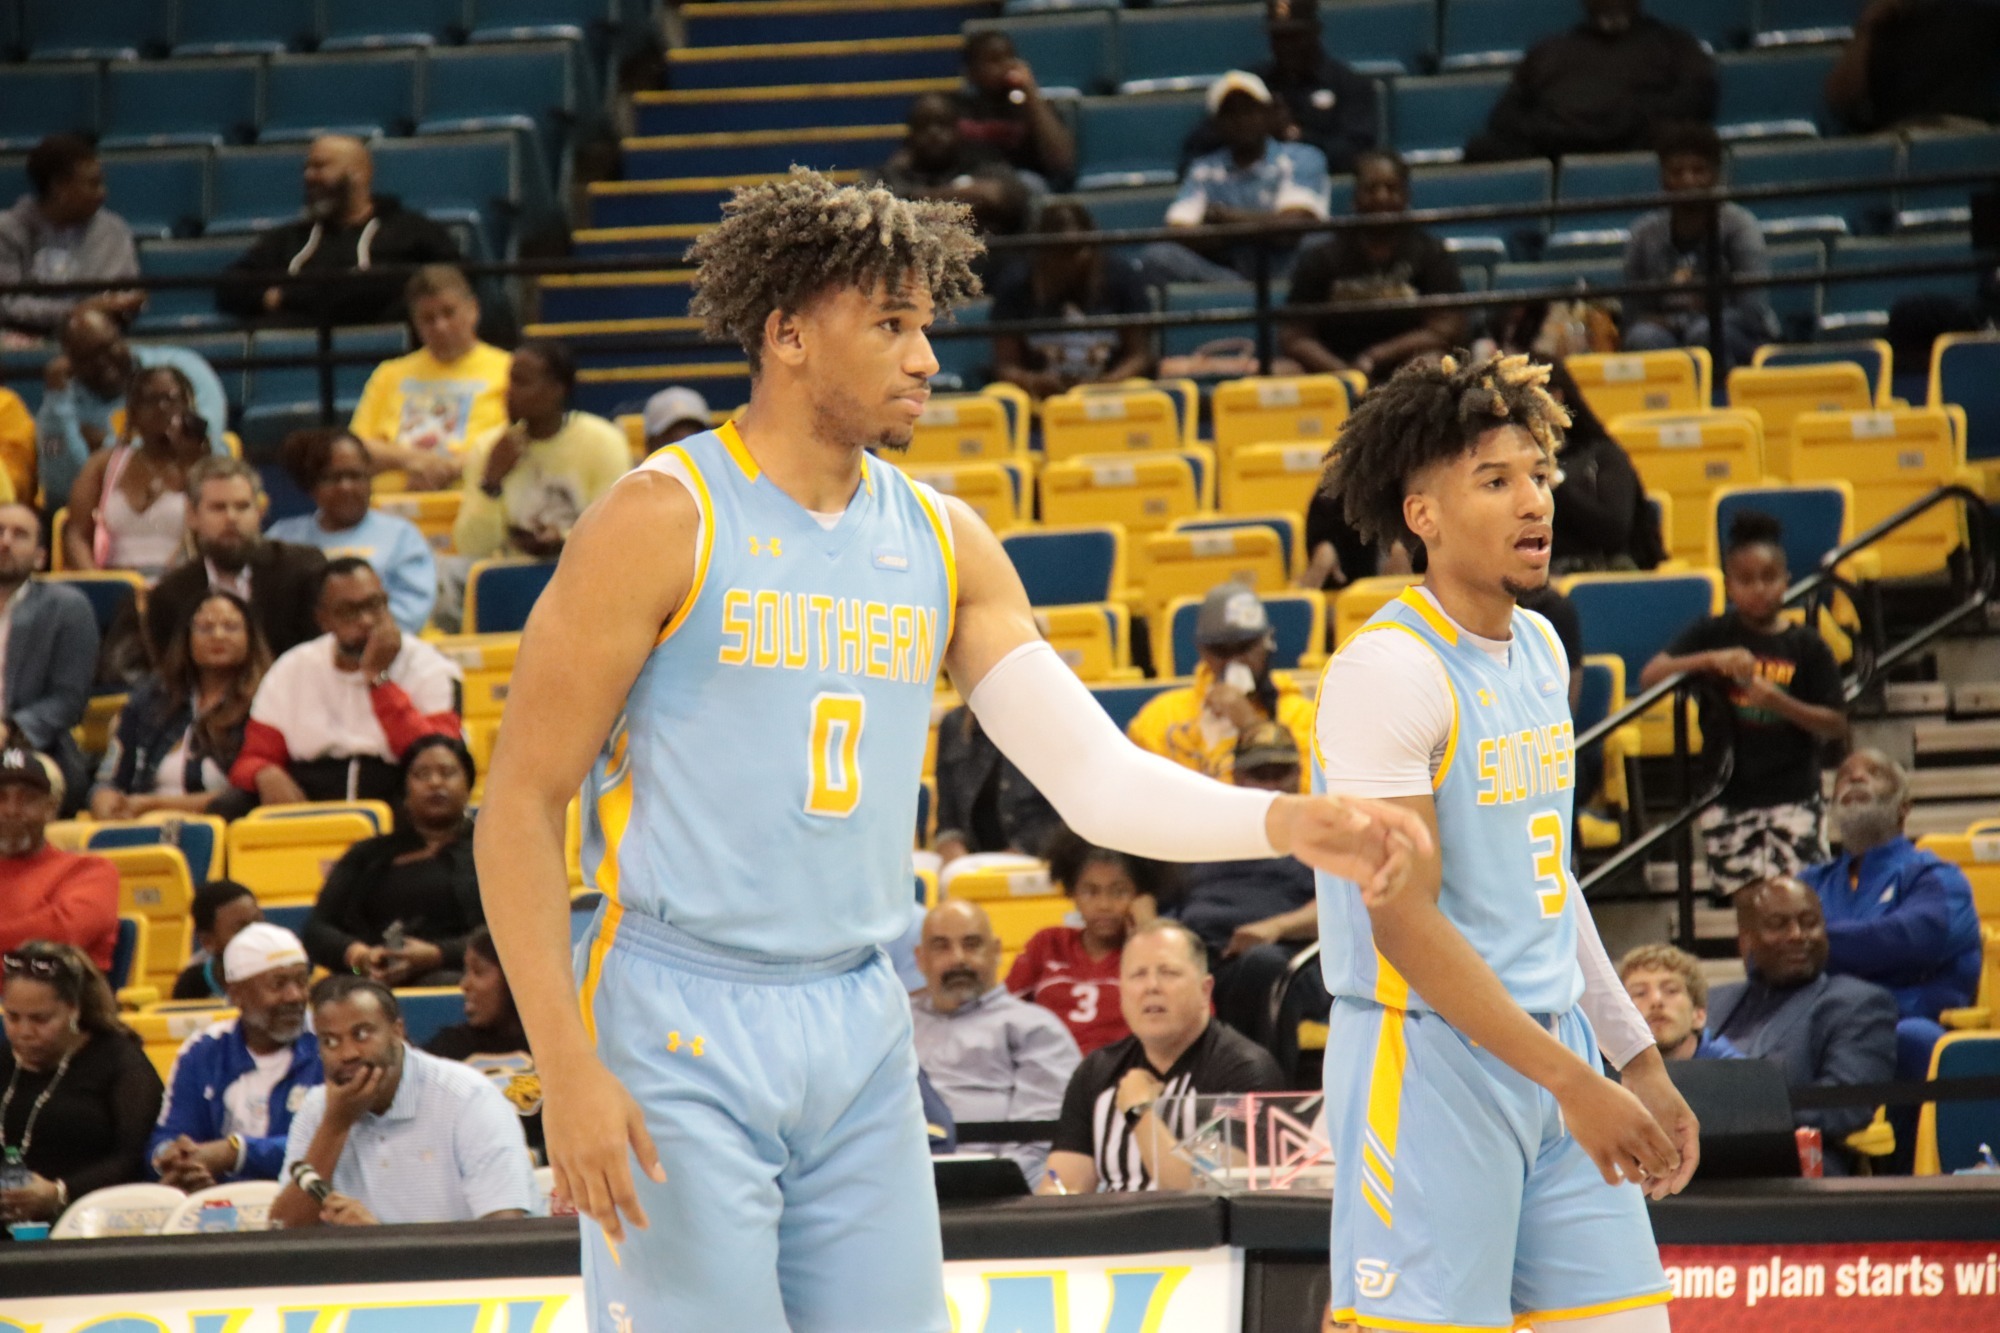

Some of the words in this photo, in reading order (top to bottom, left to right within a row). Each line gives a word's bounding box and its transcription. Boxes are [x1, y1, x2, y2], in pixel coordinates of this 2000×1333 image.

[718, 588, 938, 685] SOUTHERN
[803, 691, 865, 819] 0
[1476, 719, 1575, 806] SOUTHER
[1527, 809, 1568, 919] 3
[1068, 983, 1099, 1022] 3
[1664, 1265, 1737, 1298] ame
[1746, 1256, 1826, 1307] plan
[1835, 1255, 1945, 1297] starts
[1955, 1252, 2000, 1296] wi
